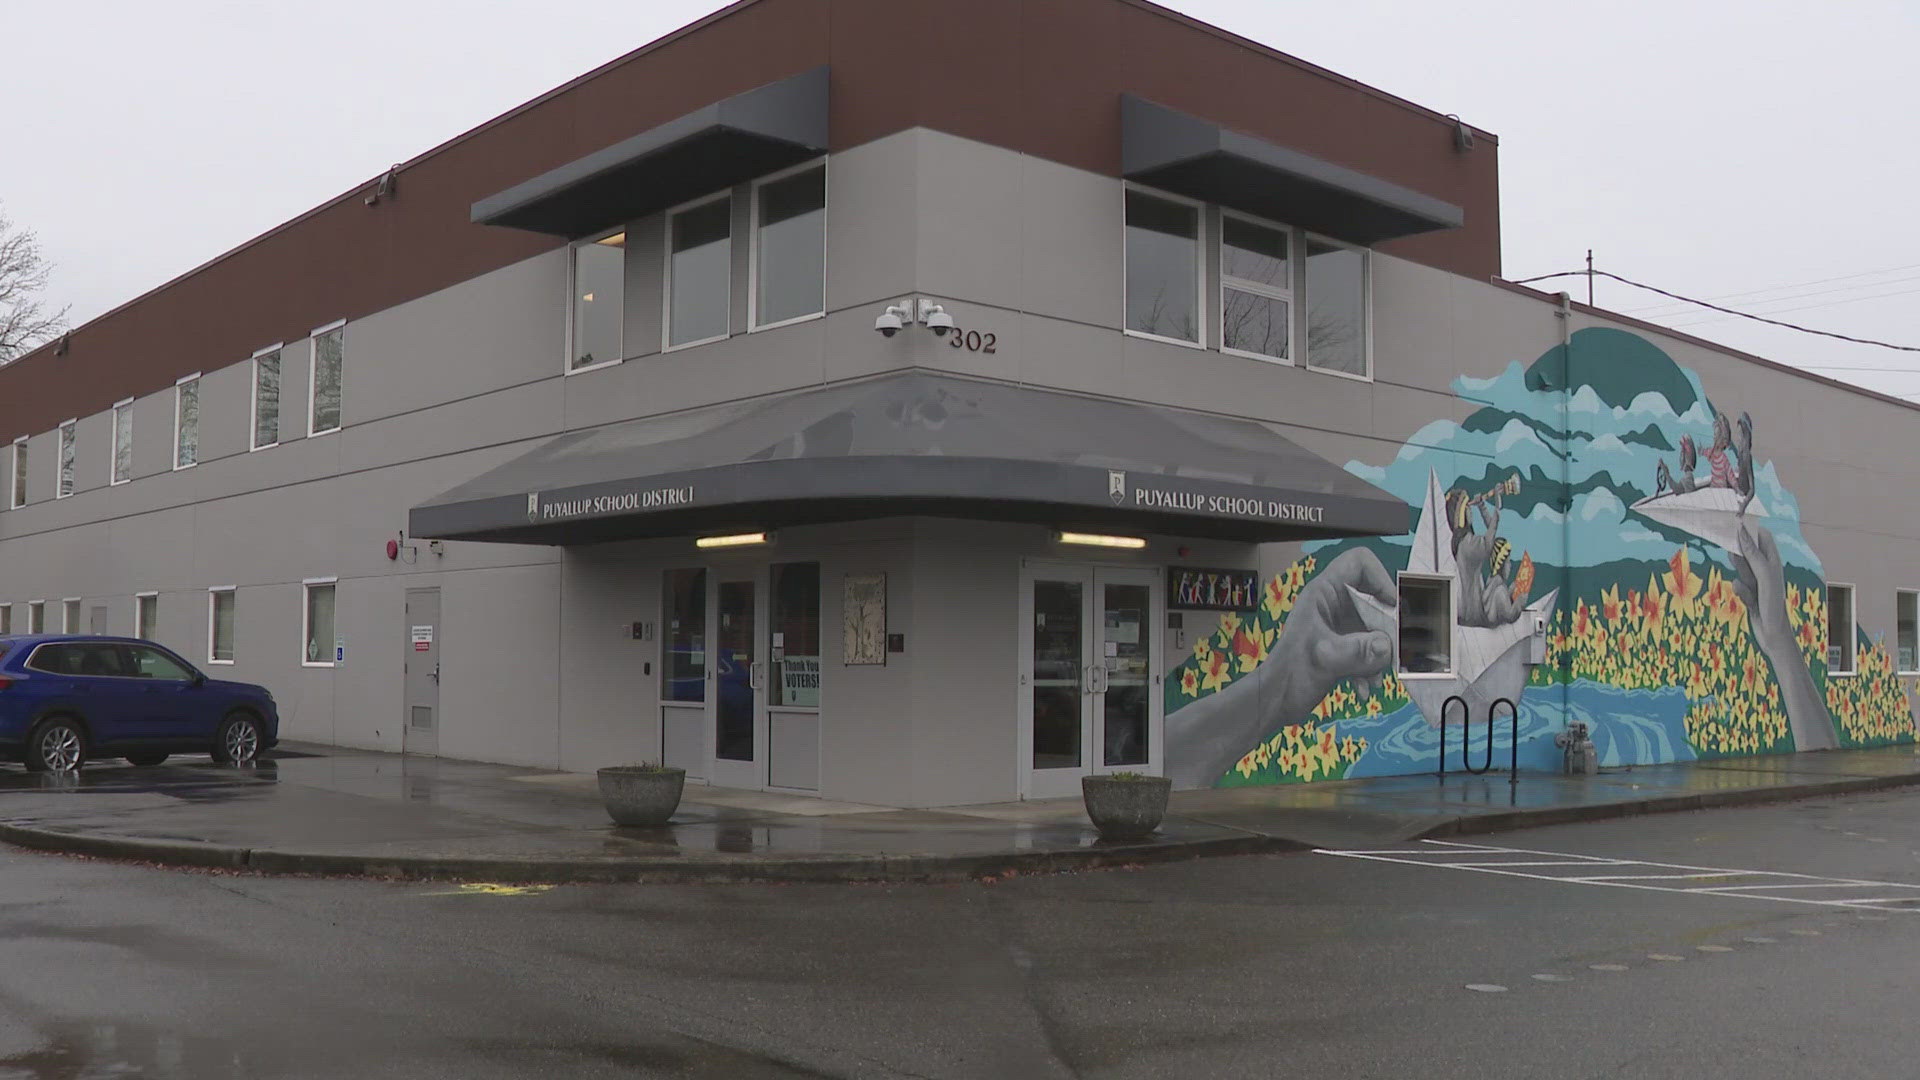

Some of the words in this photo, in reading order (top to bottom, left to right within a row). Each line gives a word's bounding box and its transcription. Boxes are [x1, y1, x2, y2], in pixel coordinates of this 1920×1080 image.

[950, 327, 996, 354] 302
[543, 499, 592, 519] PUYALLUP
[594, 493, 640, 513] SCHOOL
[1135, 488, 1205, 511] PUYALLUP
[1208, 496, 1265, 517] SCHOOL
[1268, 503, 1324, 523] DISTRICT
[785, 673, 820, 688] VOTERS!
